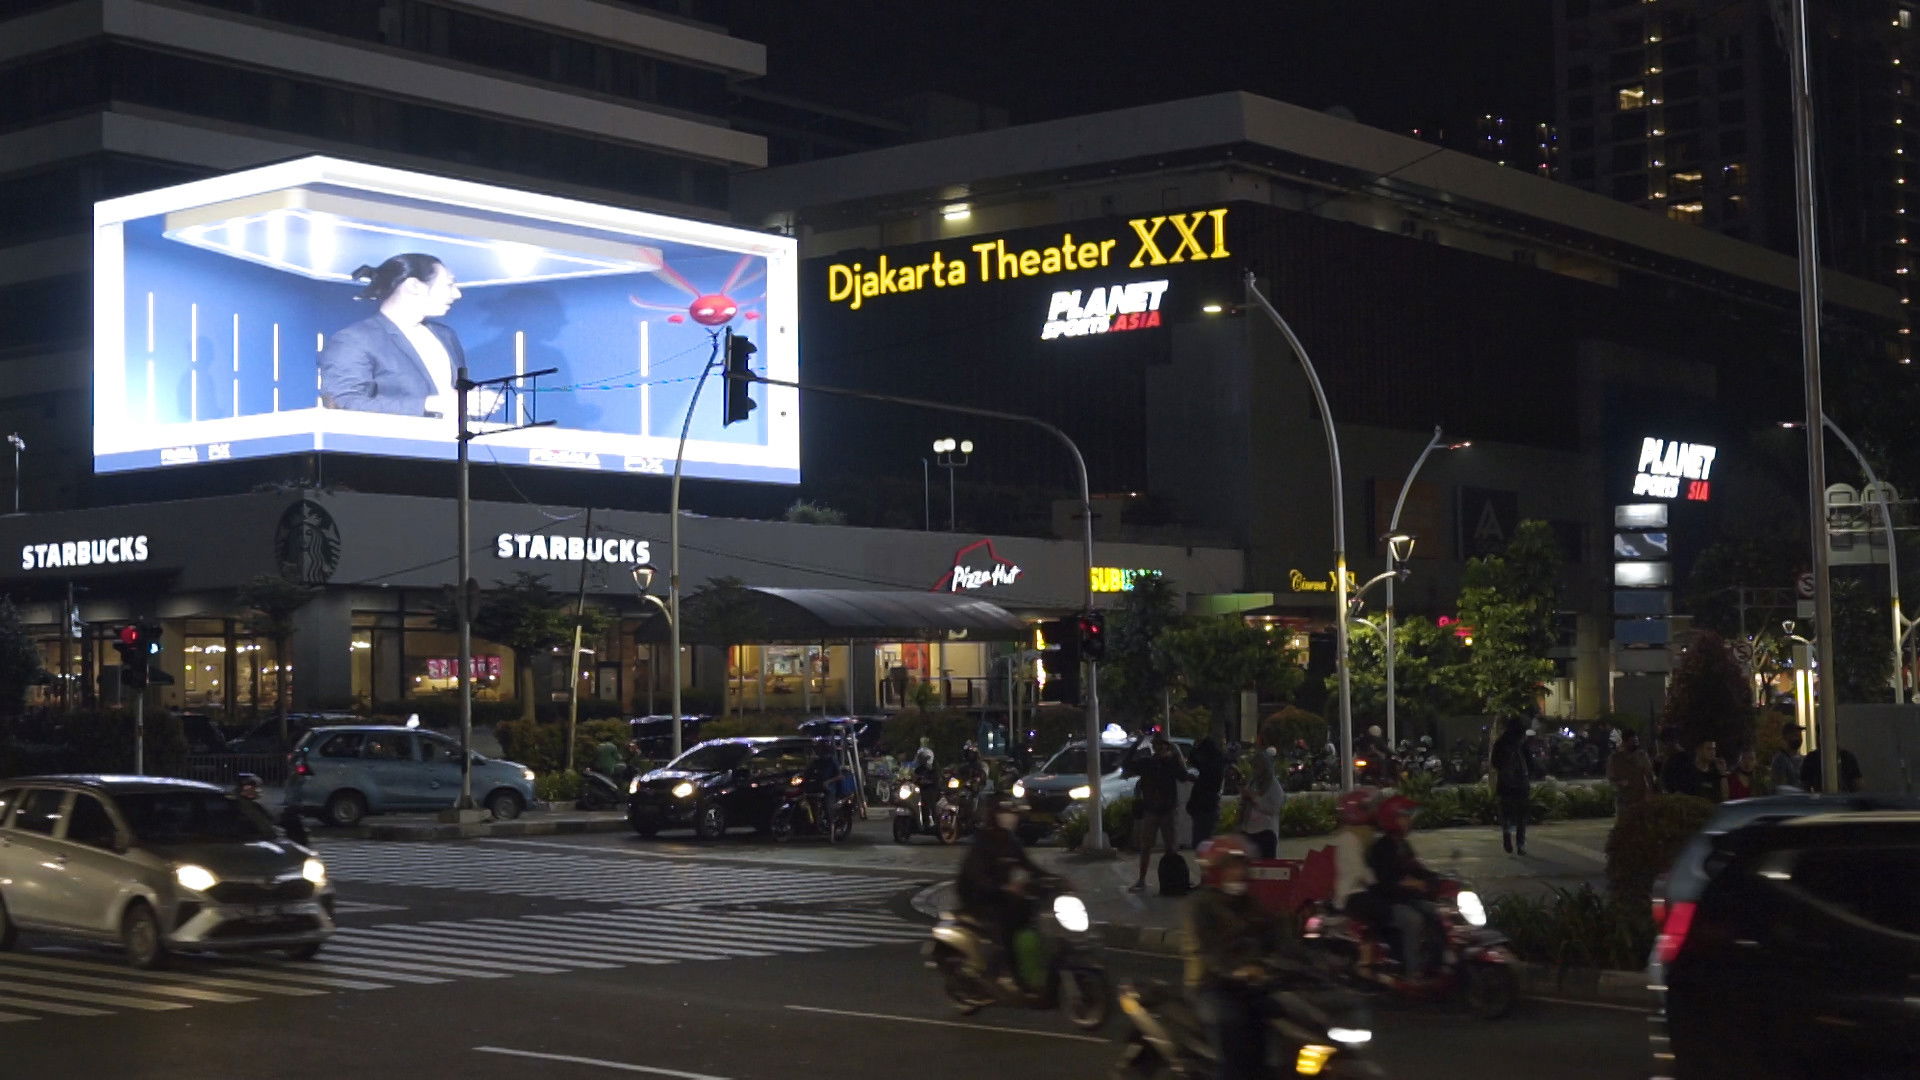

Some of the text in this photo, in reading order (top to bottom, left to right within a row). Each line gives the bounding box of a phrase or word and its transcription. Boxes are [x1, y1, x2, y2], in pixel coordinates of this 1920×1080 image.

[828, 208, 1230, 310] Djakarta Theater XXI
[1047, 279, 1169, 321] PLANET
[1637, 437, 1717, 480] PLANET
[22, 535, 149, 570] STARBUCKS
[497, 532, 651, 565] STARBUCKS
[951, 563, 1022, 592] Pizza Hut
[1090, 566, 1163, 592] SUB
